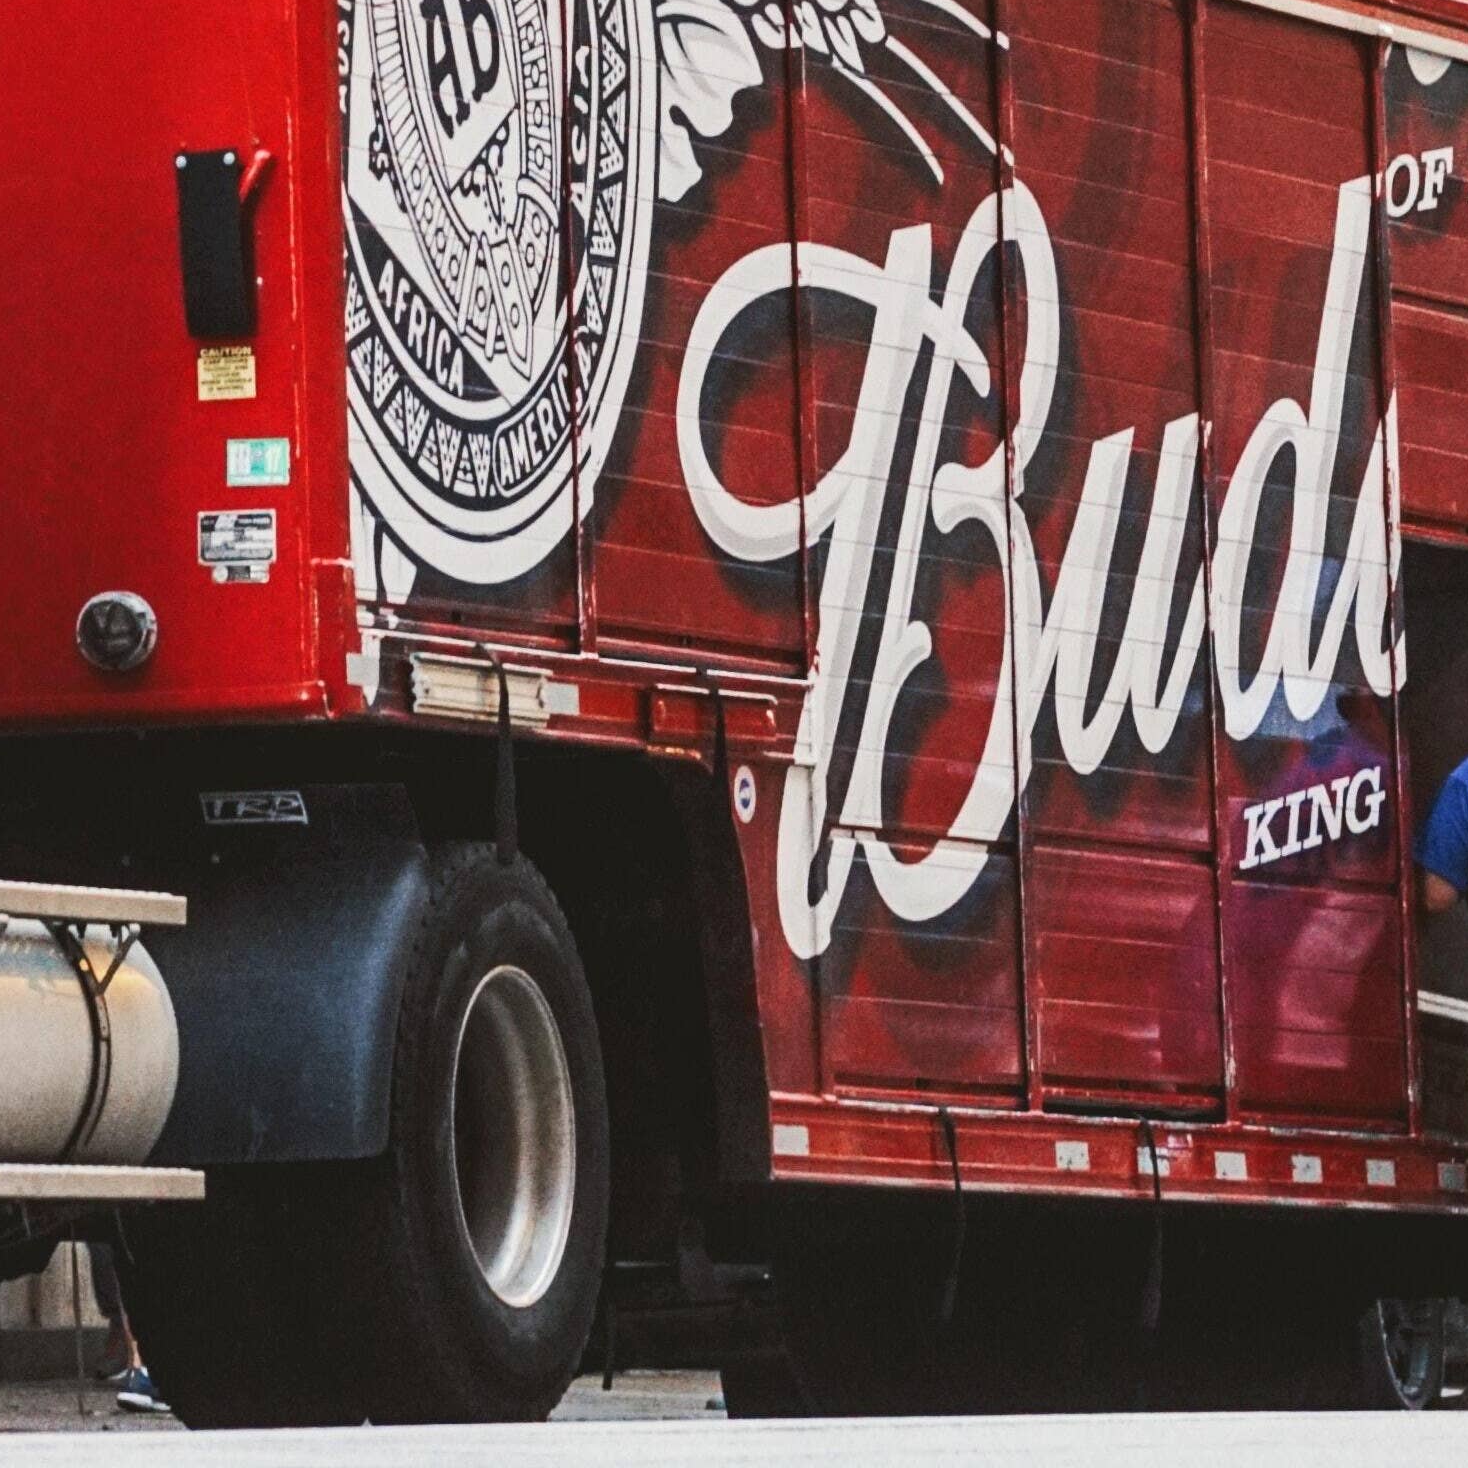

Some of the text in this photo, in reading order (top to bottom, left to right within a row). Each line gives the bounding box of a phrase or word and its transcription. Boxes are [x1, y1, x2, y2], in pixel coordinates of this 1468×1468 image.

[1386, 146, 1454, 218] OF
[377, 258, 464, 398] AFRICA
[1238, 765, 1387, 870] KING
